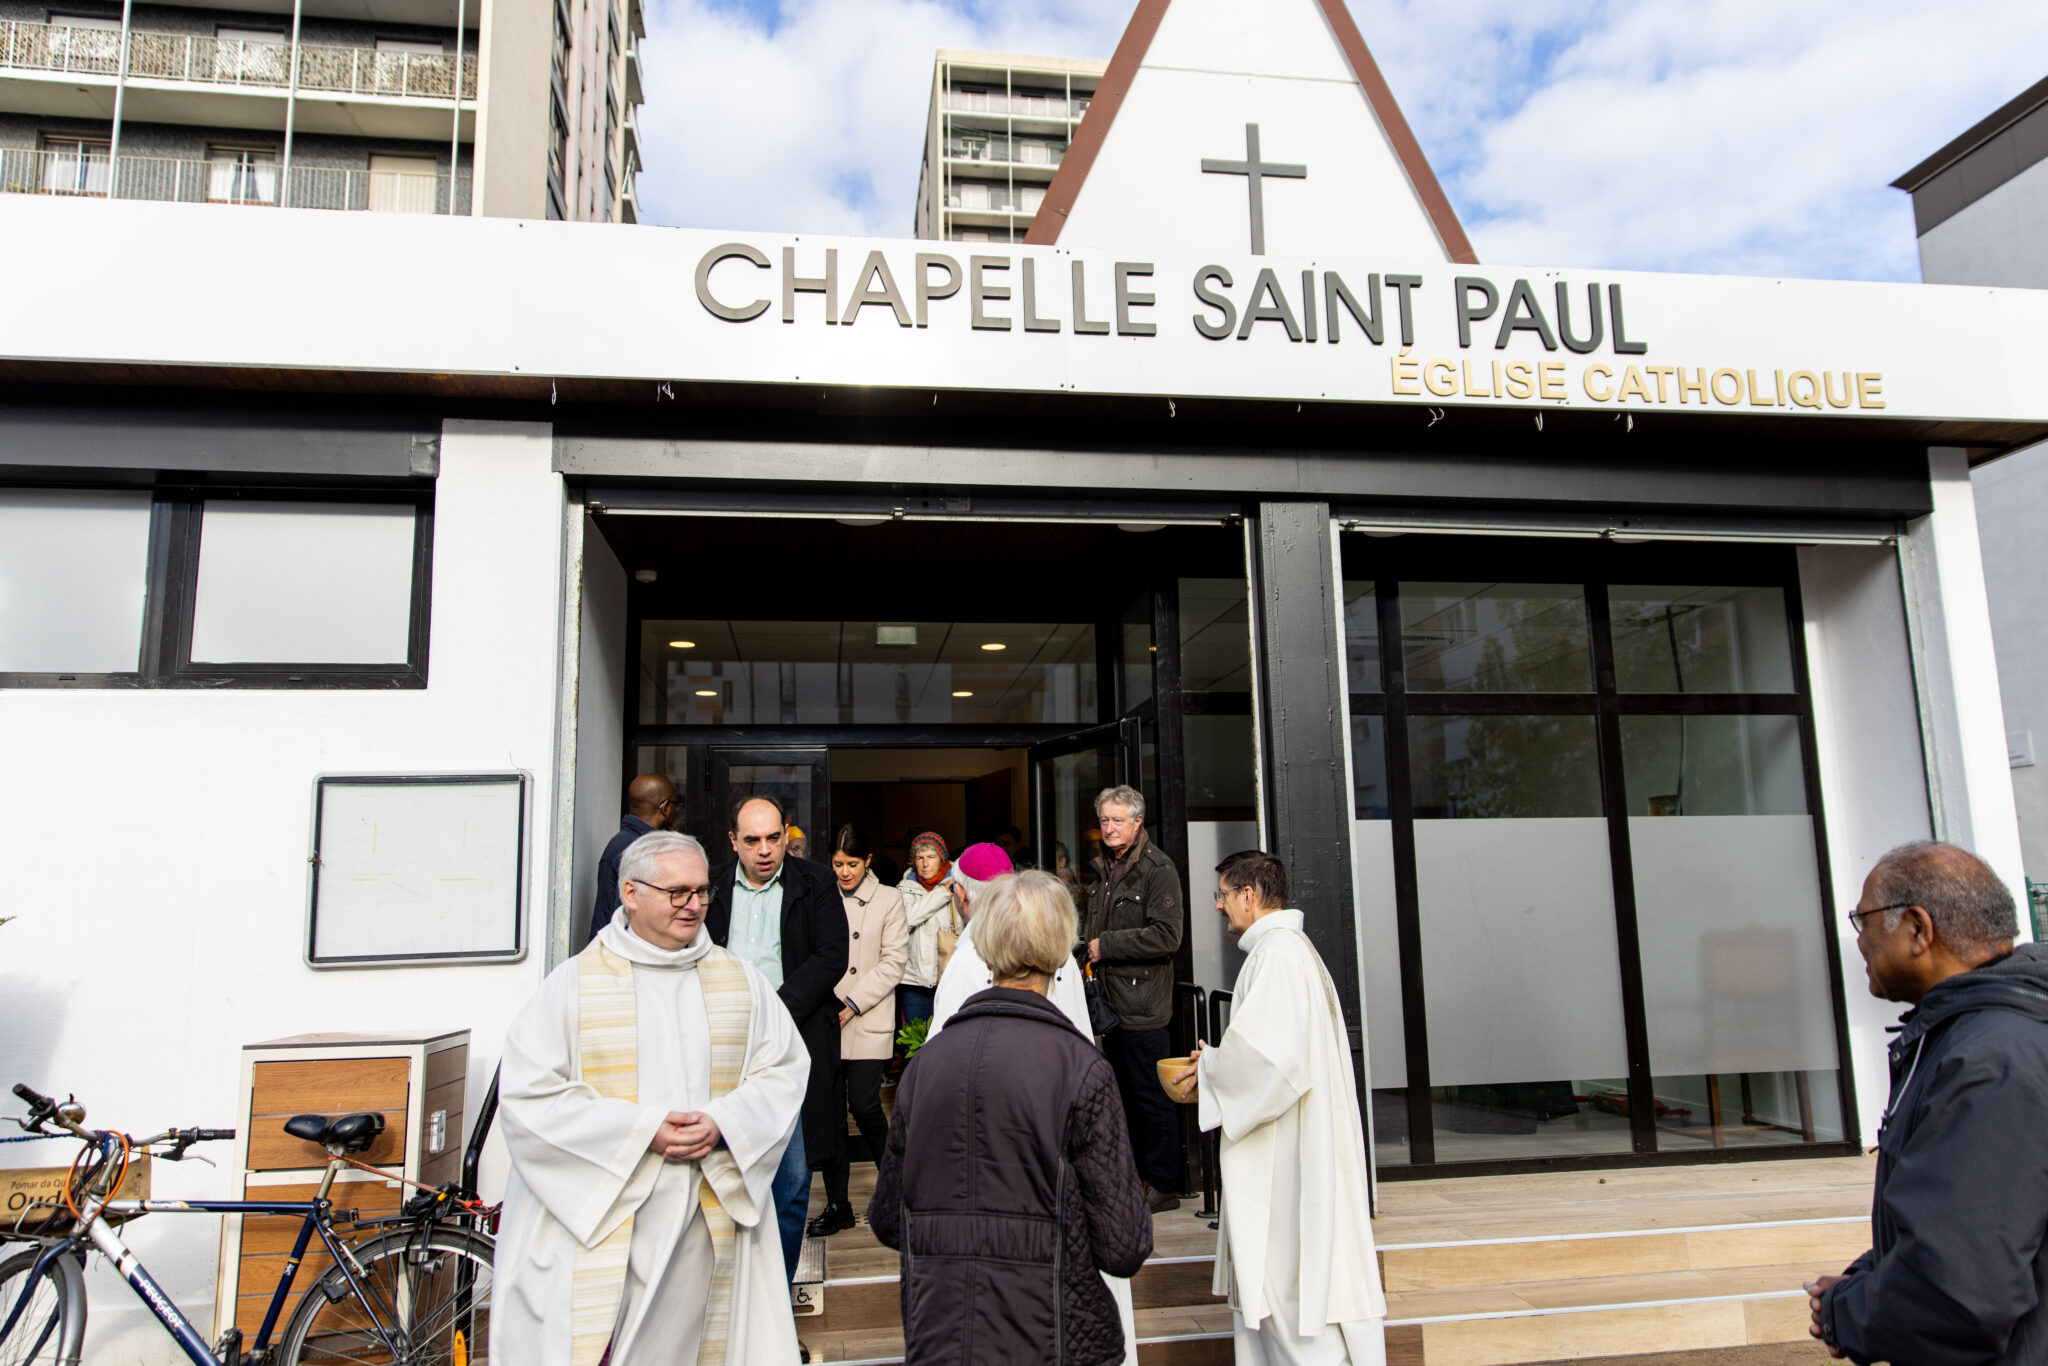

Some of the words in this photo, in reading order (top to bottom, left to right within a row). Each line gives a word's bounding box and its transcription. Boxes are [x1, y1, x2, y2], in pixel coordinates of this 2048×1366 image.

[694, 242, 1157, 337] CHAPELLE
[1193, 264, 1423, 346] SAINT
[1455, 276, 1648, 355] PAUL
[1391, 345, 1569, 400] ÉGLISE
[1583, 363, 1886, 411] CATHOLIQUE
[140, 1279, 184, 1328] PEUGEOT
